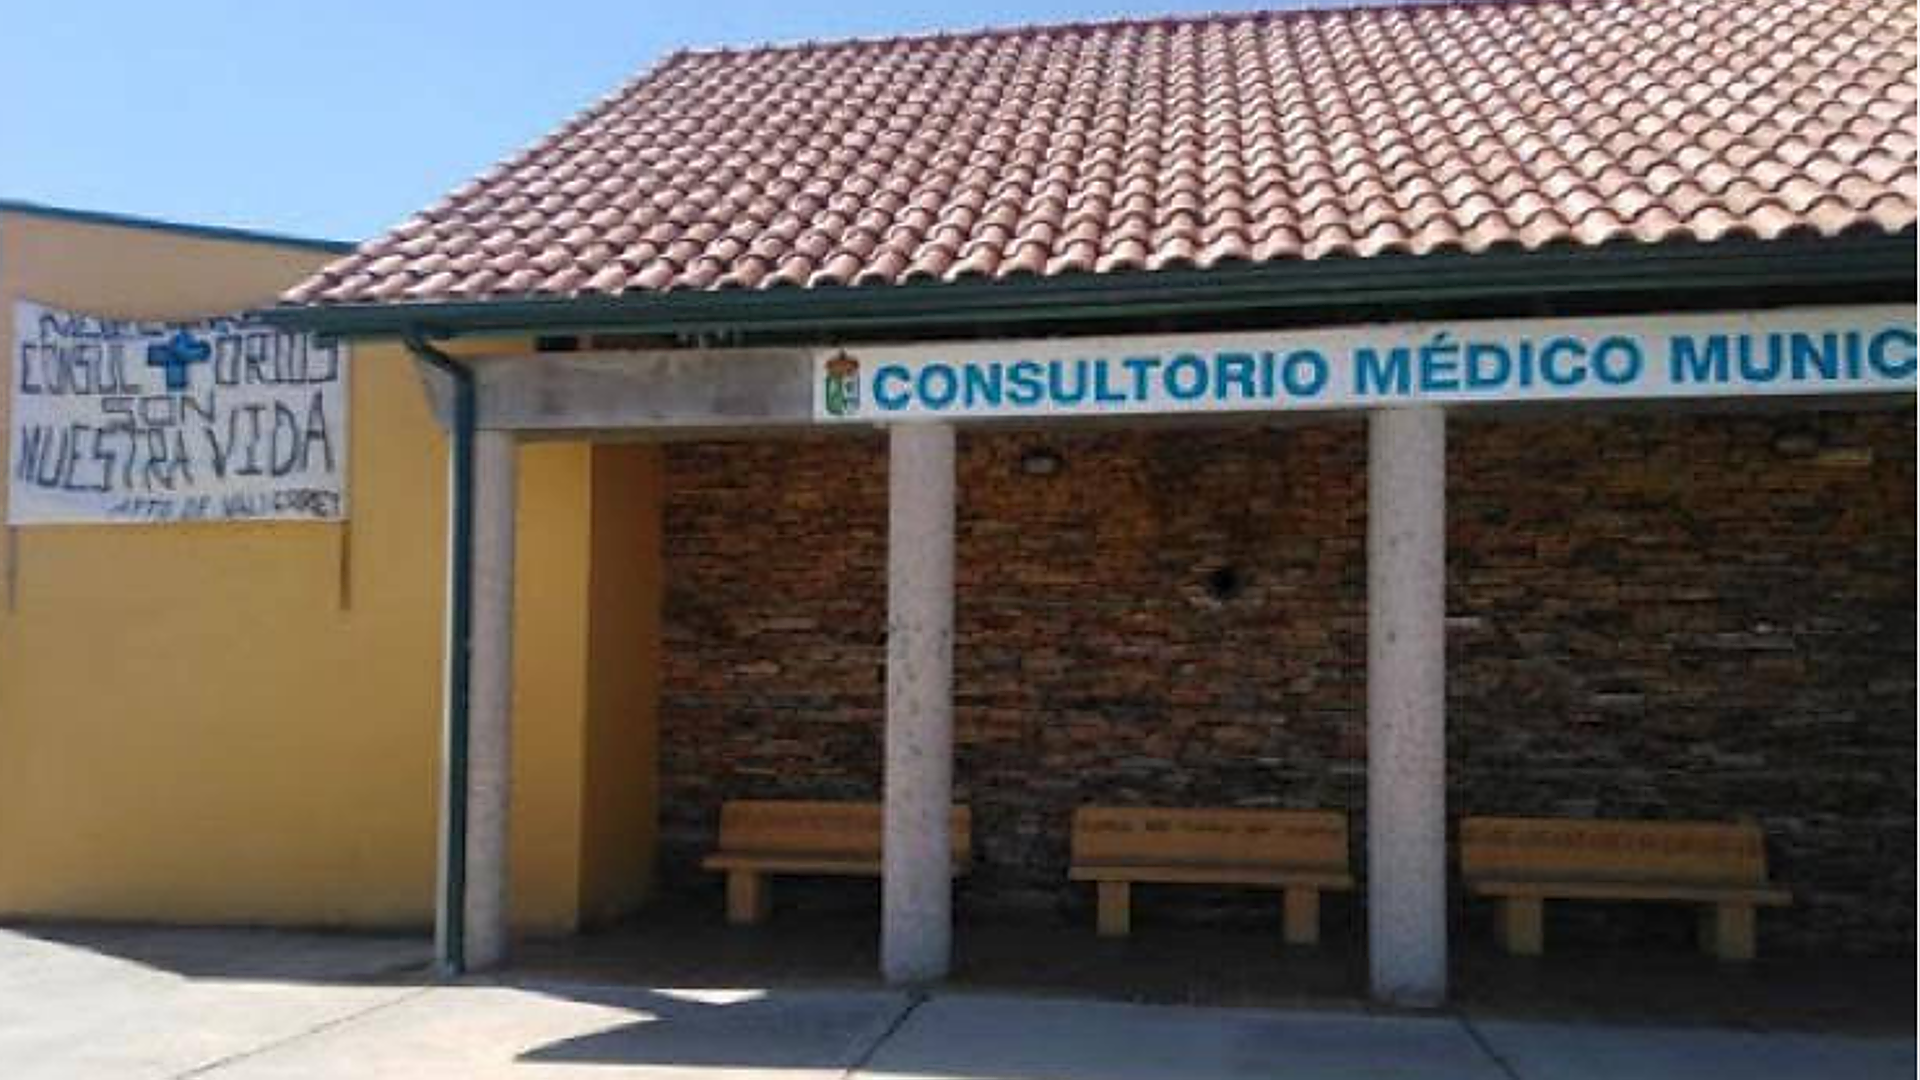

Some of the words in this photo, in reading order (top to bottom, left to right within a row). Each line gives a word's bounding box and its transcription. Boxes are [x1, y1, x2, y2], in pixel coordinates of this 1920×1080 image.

[99, 390, 217, 427] SON
[872, 350, 1329, 411] CONSULTORIO
[1353, 331, 1645, 395] MÉDICO
[18, 421, 194, 493] NUESTRA
[204, 391, 336, 478] VIDA
